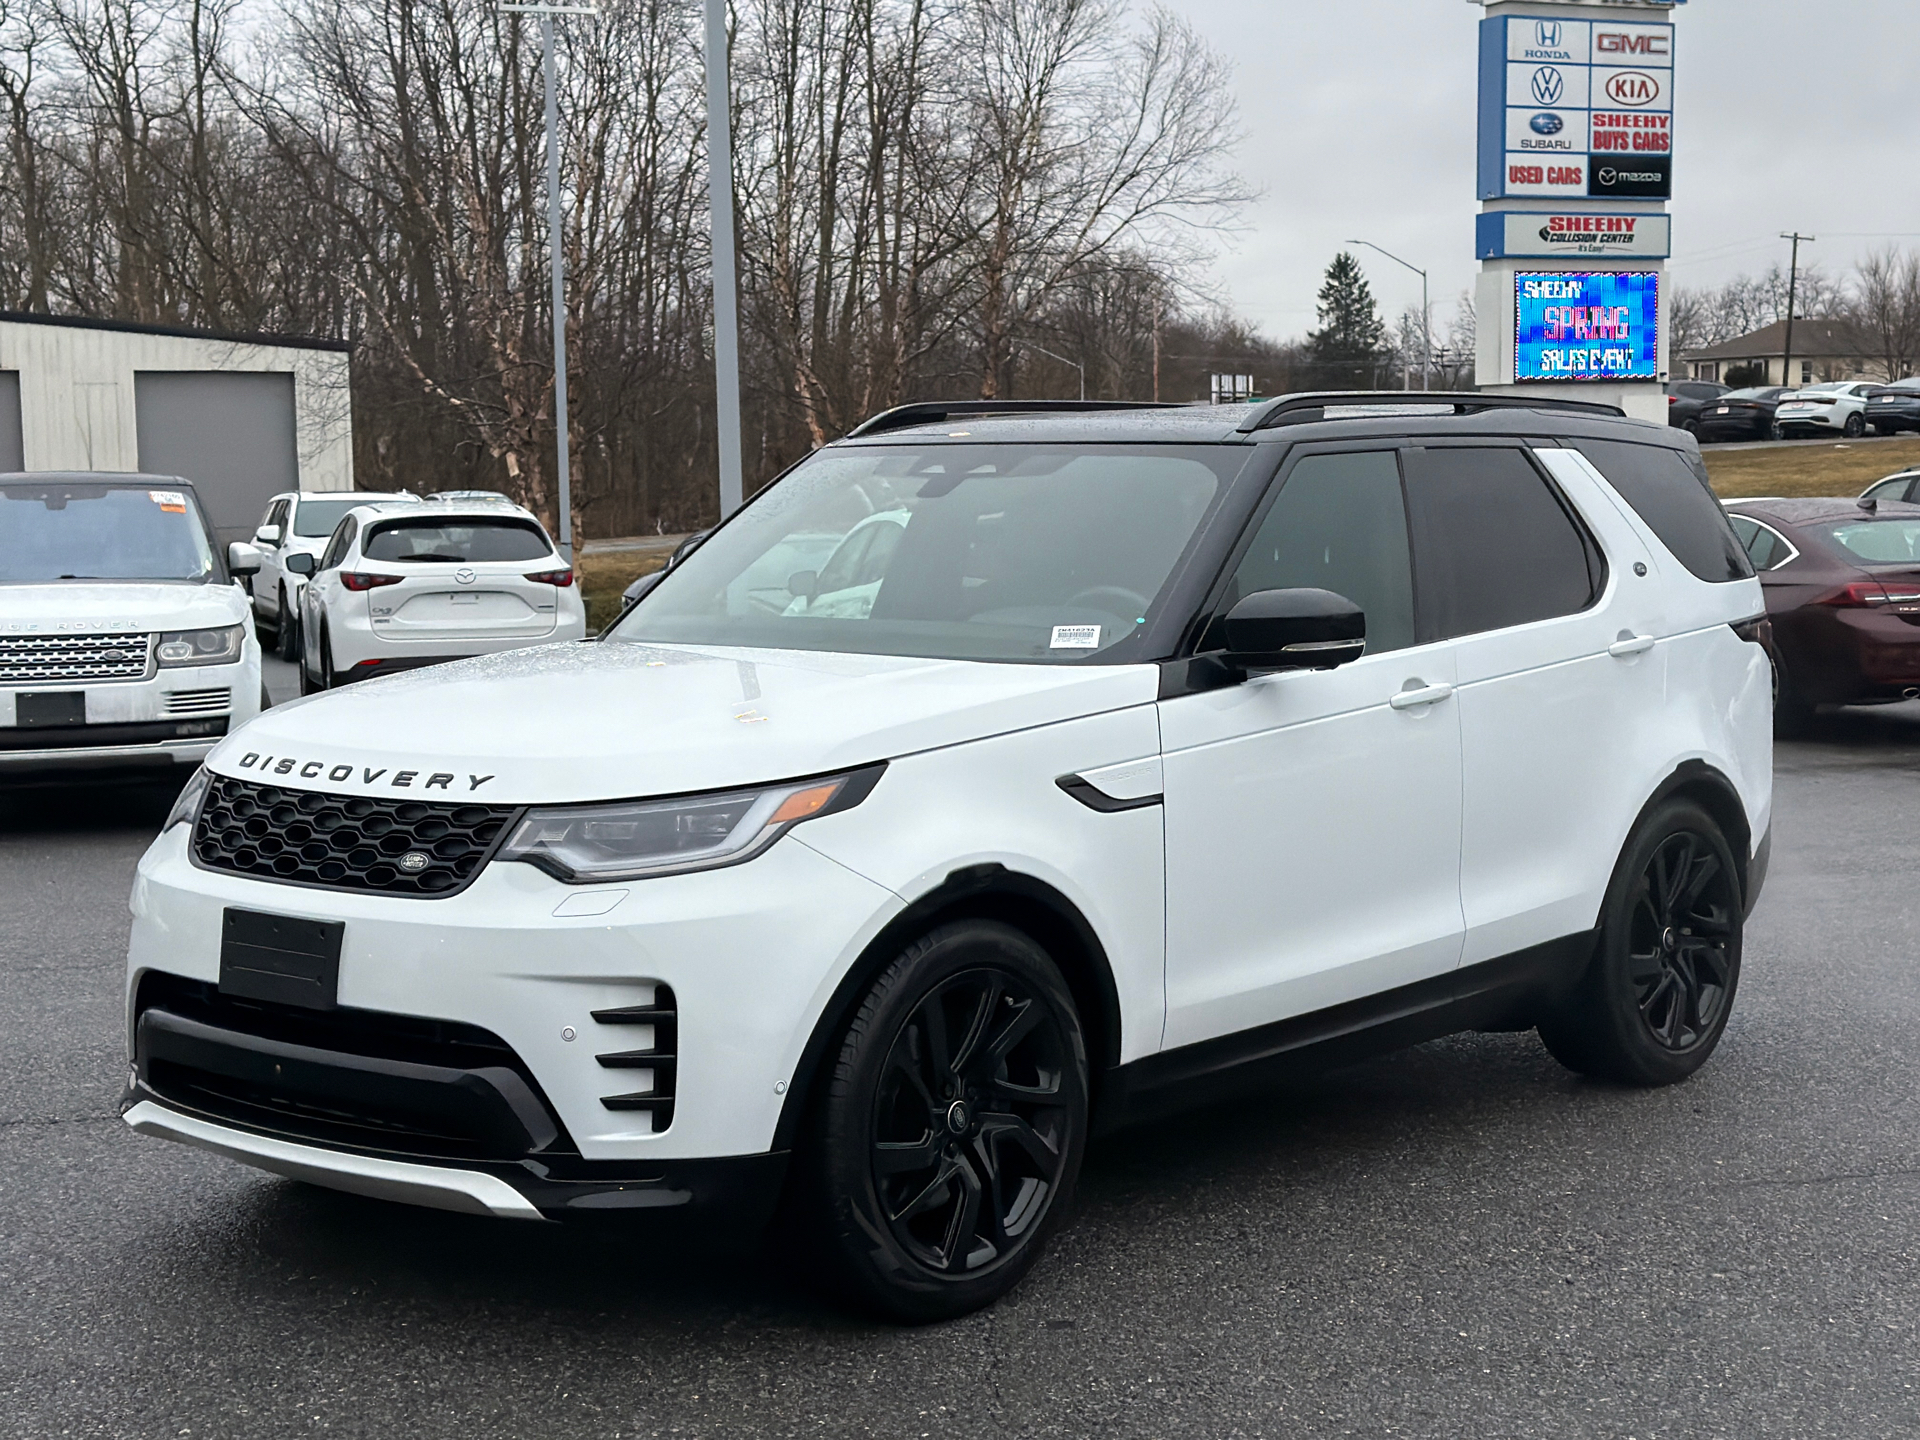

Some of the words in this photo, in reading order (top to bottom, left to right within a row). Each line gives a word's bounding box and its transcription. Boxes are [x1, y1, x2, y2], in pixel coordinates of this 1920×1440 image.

[1597, 33, 1669, 55] GMC
[1524, 50, 1571, 60] HONDA
[1615, 79, 1650, 98] KIA
[1593, 113, 1669, 128] SHEEHY
[1521, 139, 1572, 150] SUBARU
[1593, 130, 1629, 150] BUYS
[1632, 131, 1669, 152] CARS
[1509, 165, 1544, 184] USED
[1547, 166, 1582, 185] CARS
[1618, 171, 1662, 182] mazda
[1549, 216, 1637, 232] SHEEHY
[1550, 233, 1598, 243] COLLISION
[1599, 233, 1635, 243] CENTER
[1523, 281, 1583, 298] SHEEHY
[1543, 306, 1630, 340] SPRING
[56, 620, 140, 631] ROVER
[239, 752, 495, 791] DISCOVERY
